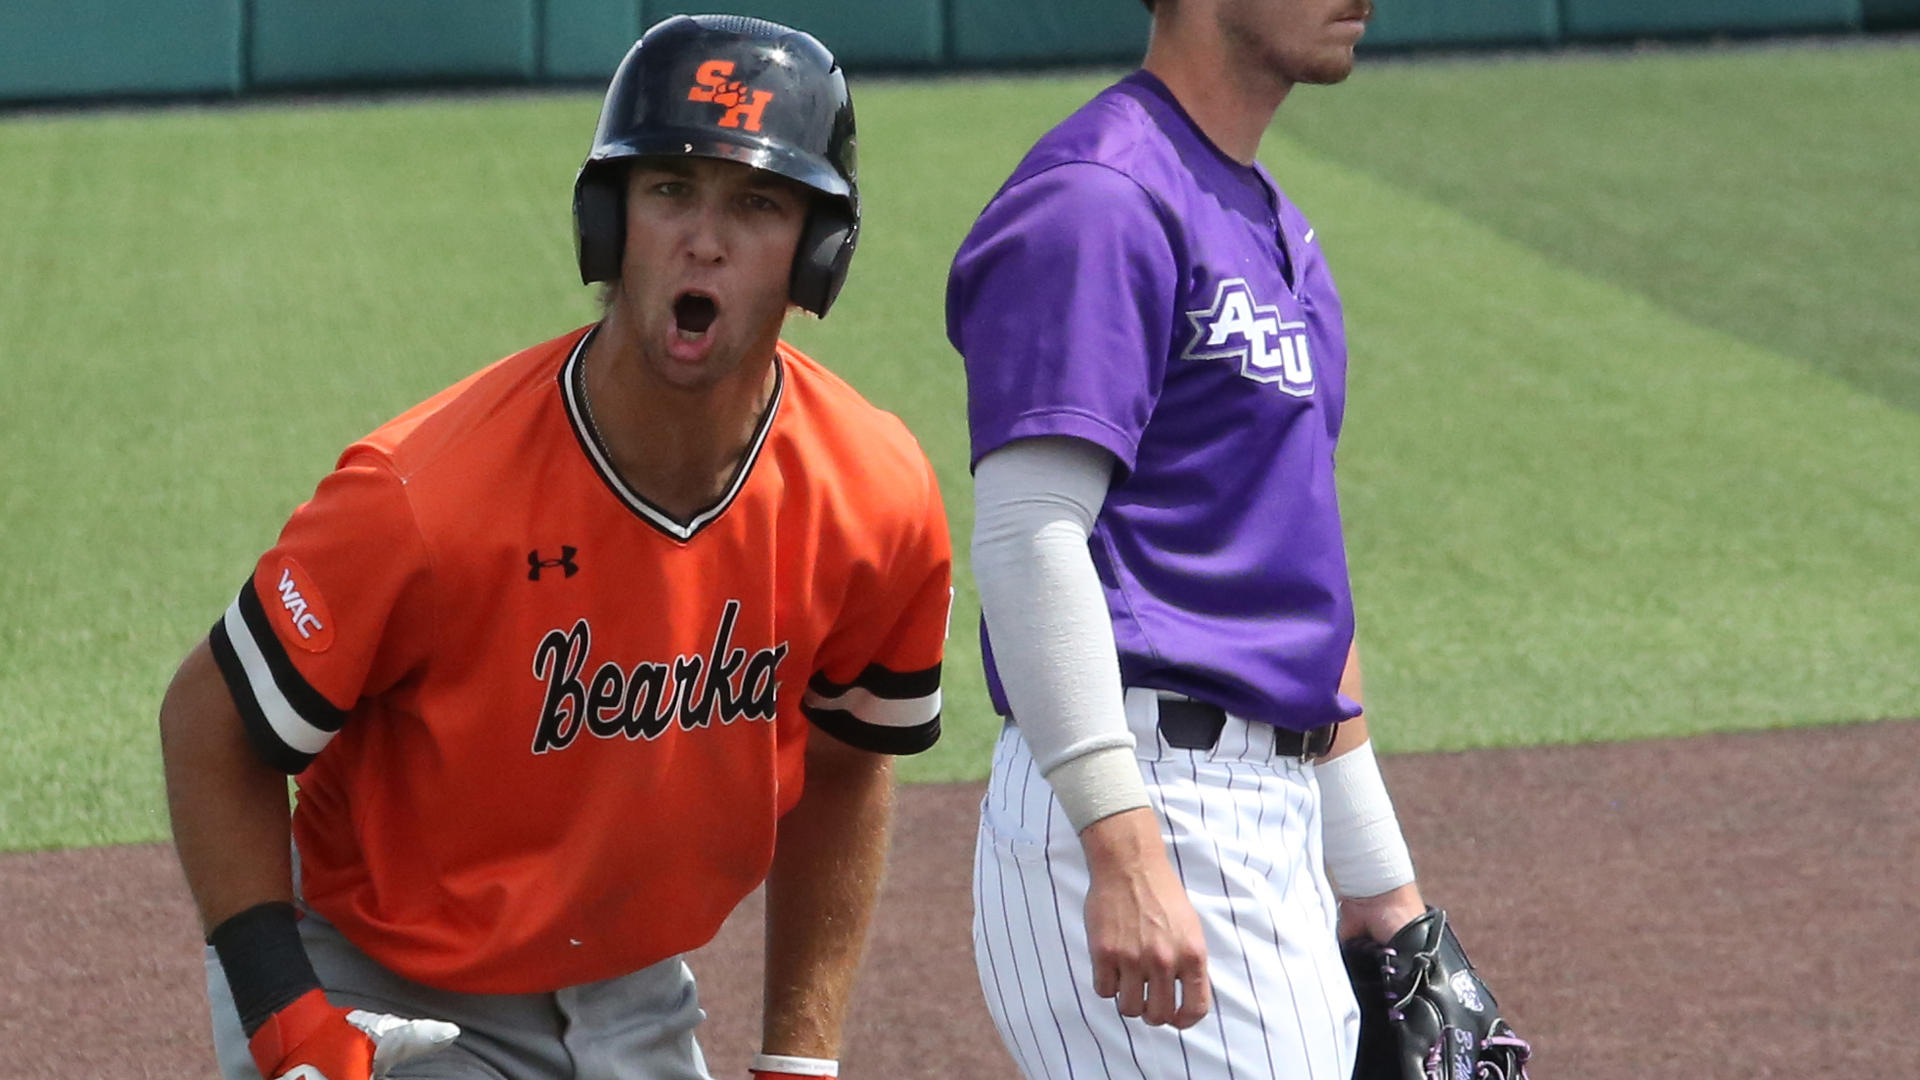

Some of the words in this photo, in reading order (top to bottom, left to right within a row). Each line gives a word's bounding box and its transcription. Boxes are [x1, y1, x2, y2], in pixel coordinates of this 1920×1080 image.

[1206, 291, 1313, 384] ACU
[278, 568, 323, 639] WAC
[532, 599, 788, 754] Bearka
